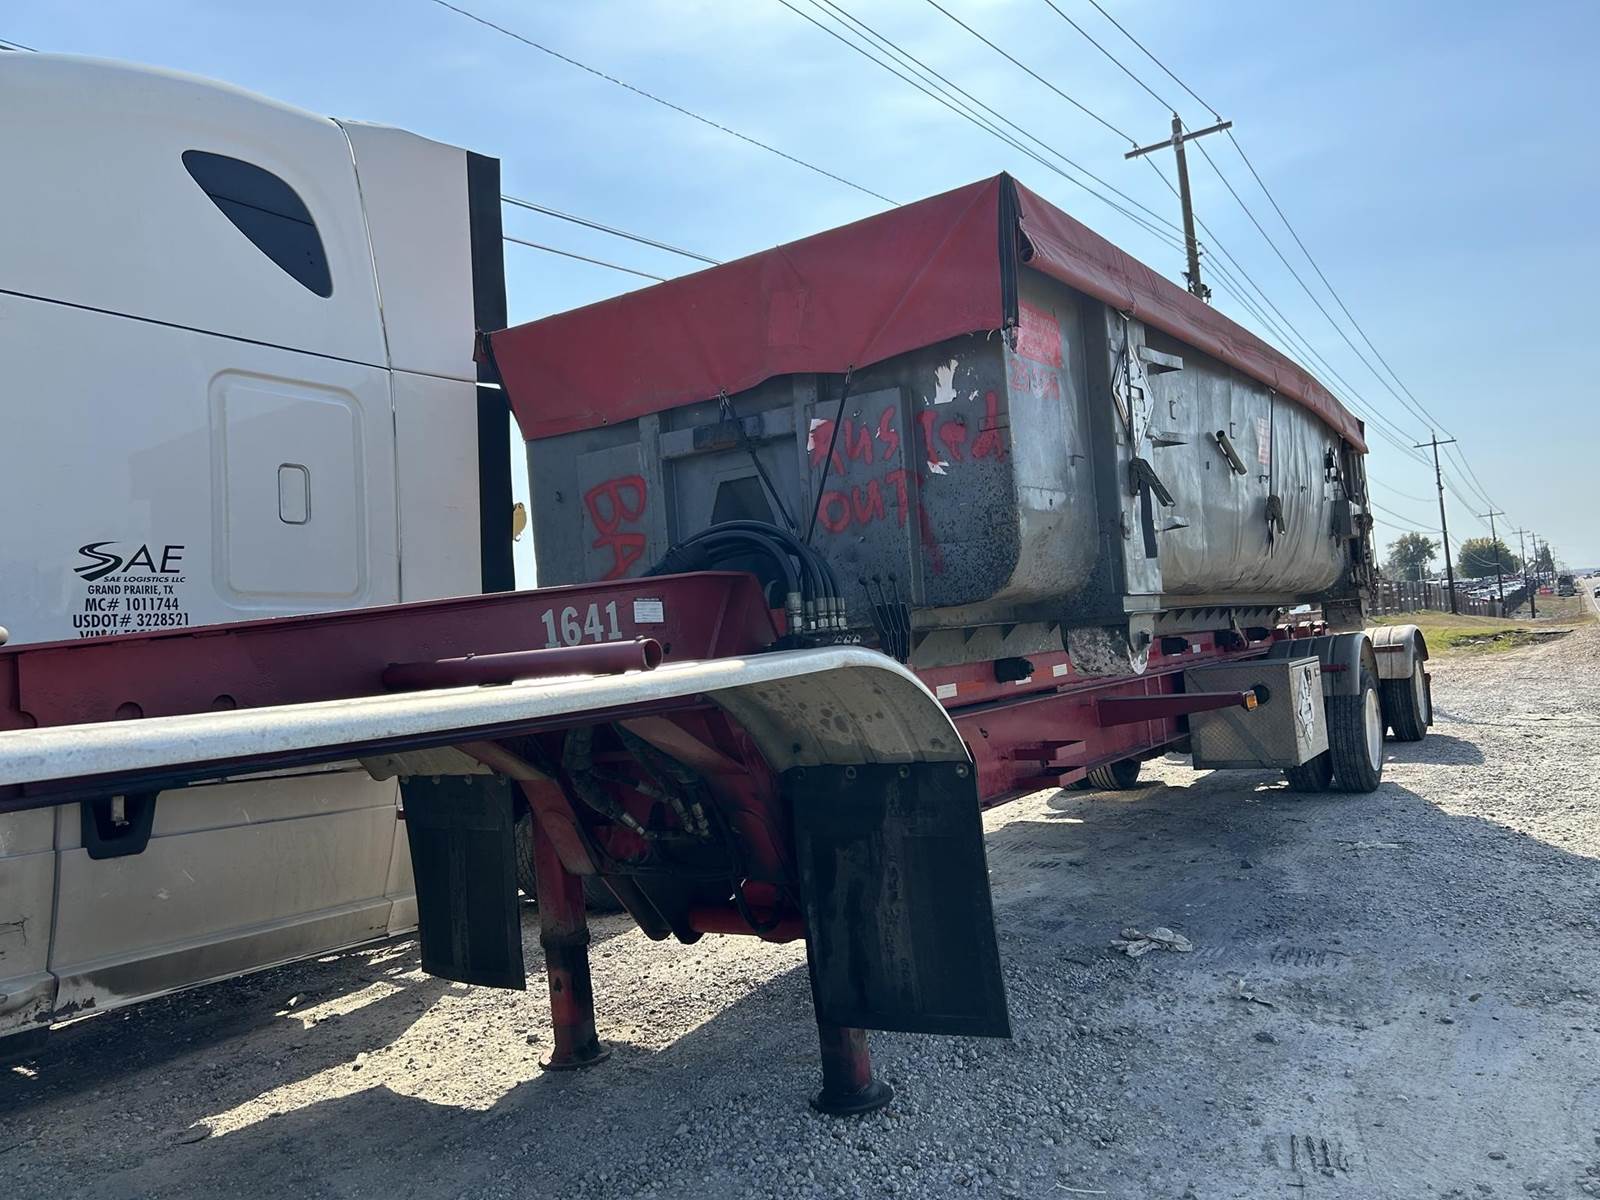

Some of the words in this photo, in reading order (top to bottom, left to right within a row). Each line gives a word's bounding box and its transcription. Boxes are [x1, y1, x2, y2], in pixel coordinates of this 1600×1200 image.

[73, 541, 185, 582] SAE
[88, 585, 121, 595] GRAND
[124, 585, 161, 596] PRAIRIE,
[163, 585, 174, 595] TX
[85, 598, 120, 611] MC#
[125, 597, 179, 611] 1011744
[73, 613, 132, 628] USDOT#
[136, 612, 189, 627] 3228521
[541, 601, 623, 649] 1641
